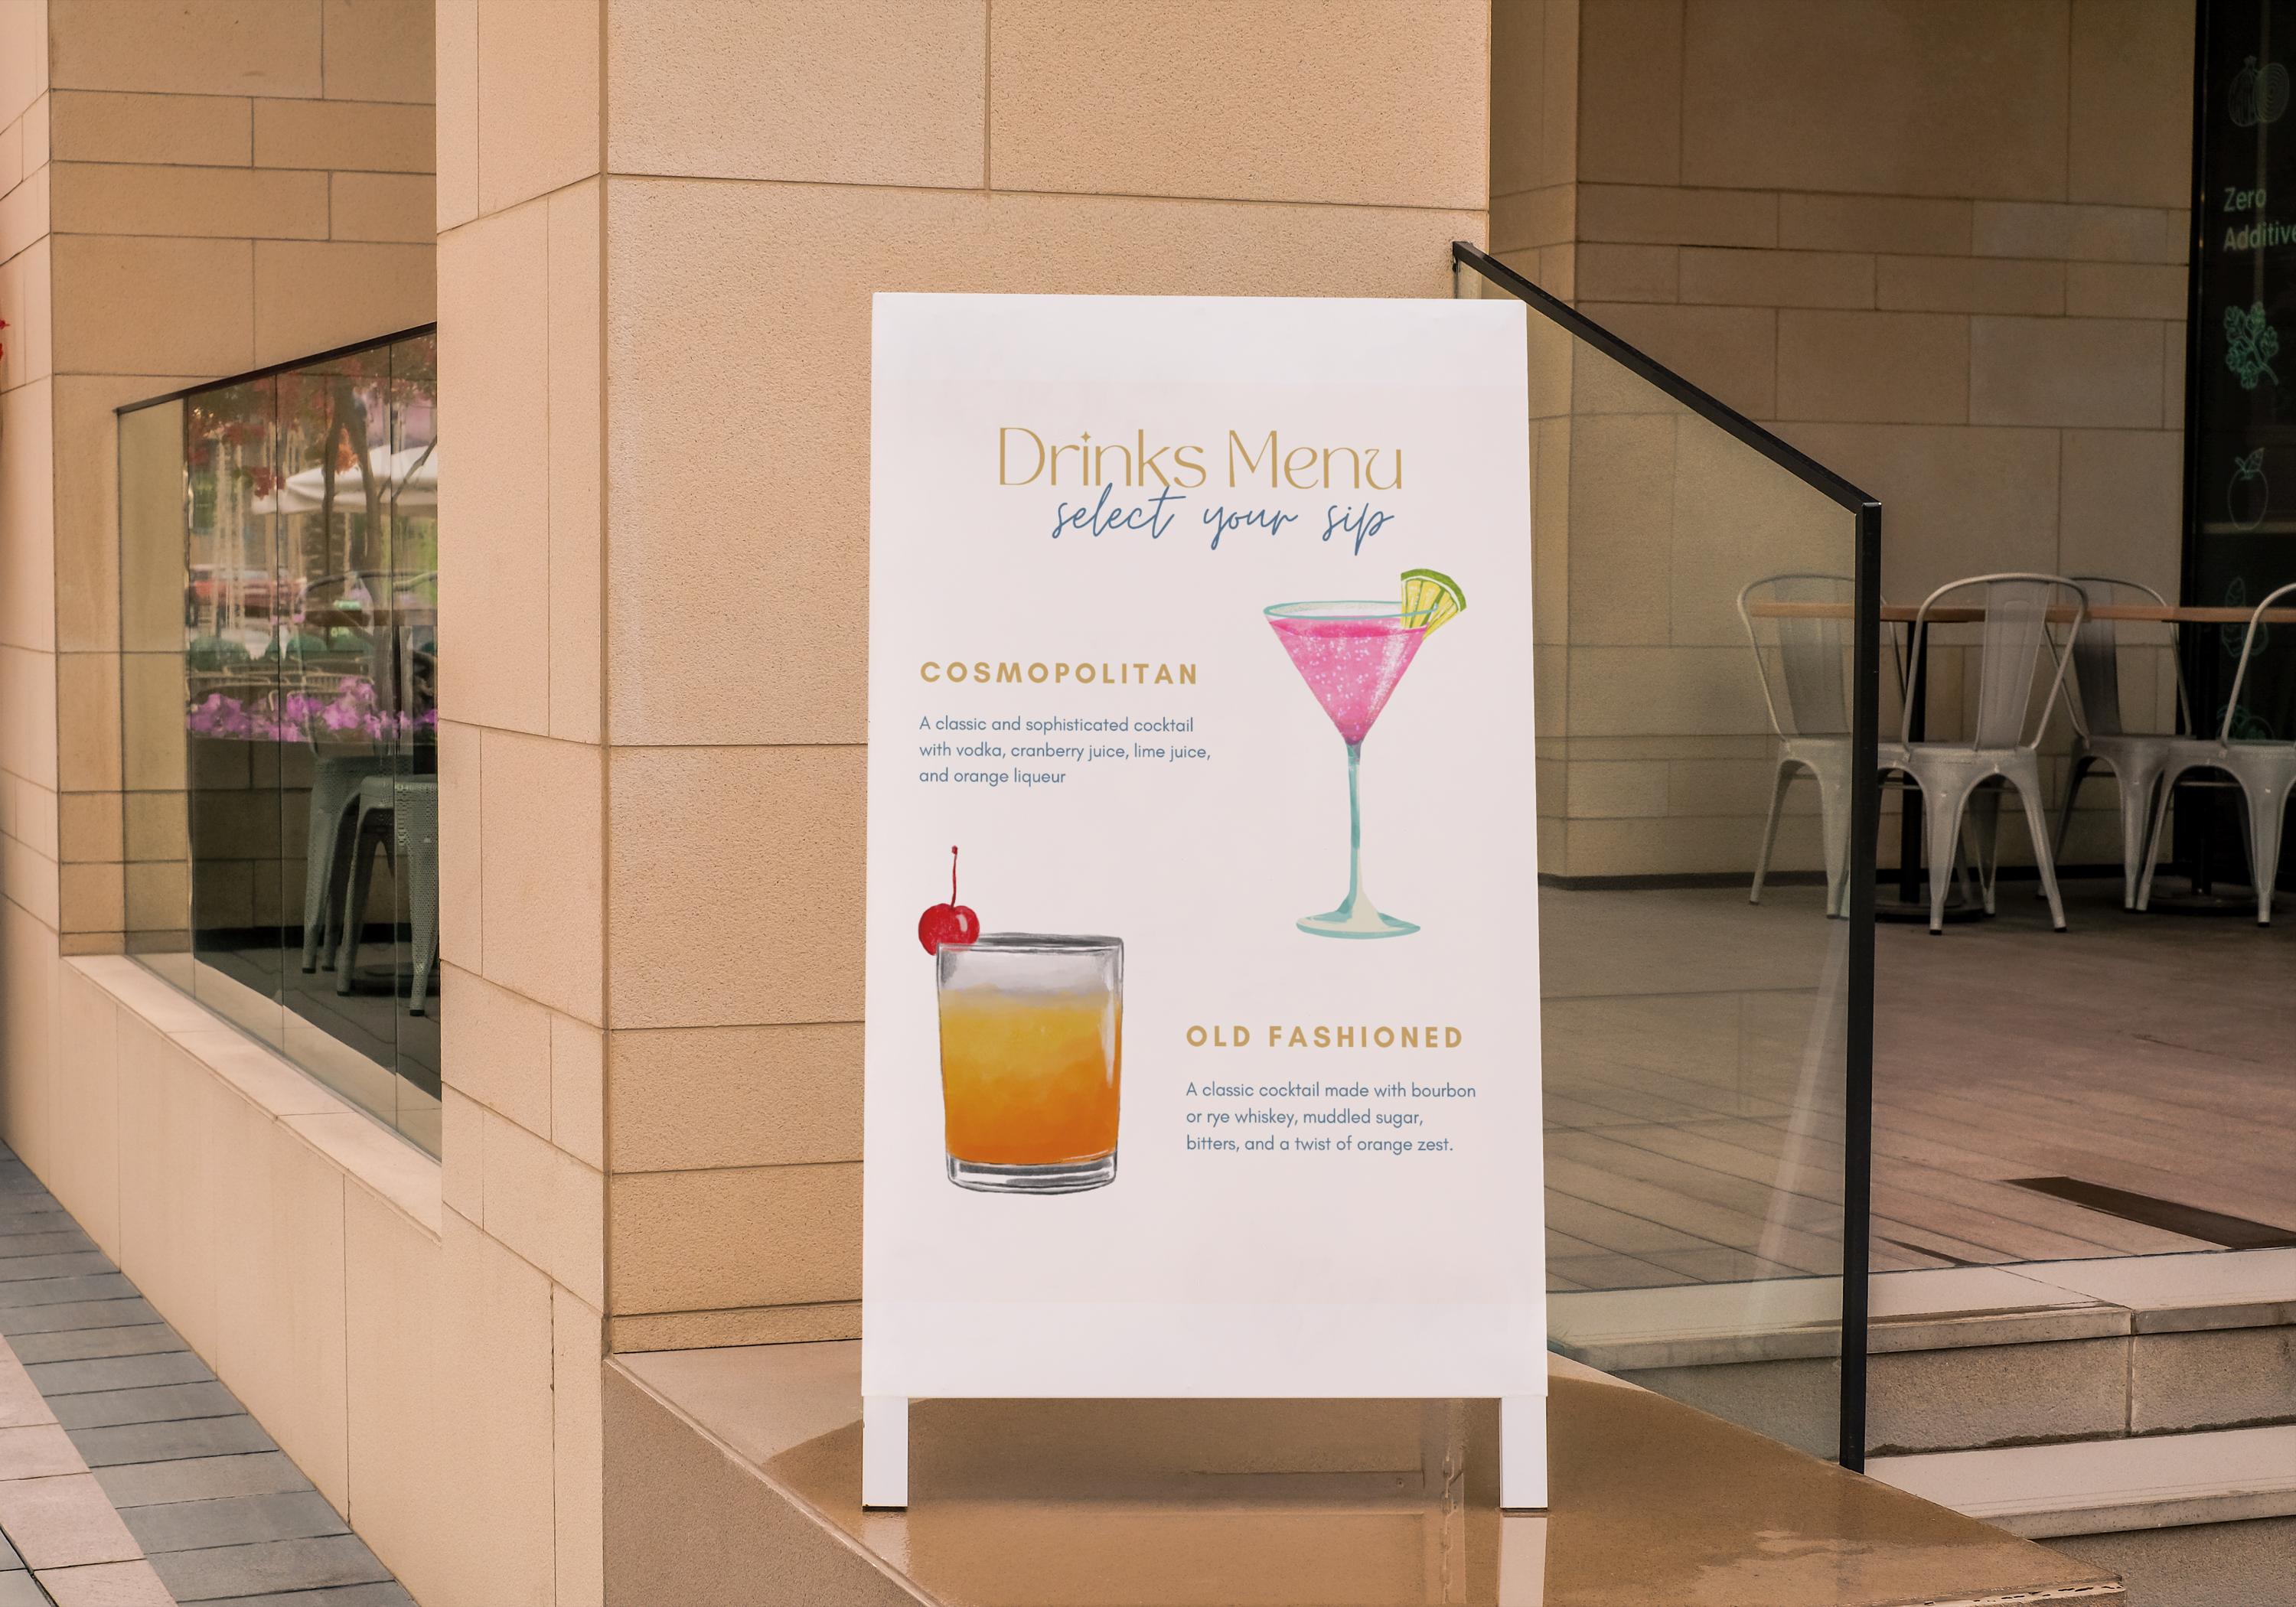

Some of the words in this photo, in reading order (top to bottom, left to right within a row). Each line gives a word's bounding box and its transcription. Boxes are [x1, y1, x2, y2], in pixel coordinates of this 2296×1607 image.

[2223, 187, 2266, 212] Zero
[999, 427, 1208, 489] Drinks
[1228, 429, 1403, 491] Menu
[1052, 482, 1187, 539] select
[1202, 505, 1299, 551] your
[1322, 502, 1396, 556] sip
[920, 661, 1198, 686] COSMOPOLITAN
[919, 716, 931, 730] A
[935, 715, 987, 731] classic
[991, 715, 1021, 731] and
[1026, 715, 1129, 735] sophisticated
[1133, 716, 1194, 732] cocktail
[919, 741, 951, 757] with
[957, 741, 1006, 759] vodka,
[1010, 742, 1084, 762] cranberry
[1088, 744, 1130, 762] juice,
[1134, 742, 1166, 758] lime
[1169, 745, 1211, 763] juice,
[919, 767, 949, 783] and
[954, 772, 1009, 787] orange
[1014, 768, 1066, 788] liqueur
[1186, 1025, 1251, 1048] OLD
[1269, 1025, 1463, 1048] FASHIONED
[1186, 1081, 1198, 1097] A
[1202, 1081, 1254, 1097] classic
[1259, 1081, 1319, 1097] cocktail
[1325, 1081, 1369, 1097] made
[1374, 1081, 1407, 1097] with
[1411, 1081, 1476, 1098] bourbon
[1186, 1112, 1202, 1123] or
[1207, 1113, 1231, 1128] rye
[1234, 1108, 1299, 1128] whiskey,
[1303, 1108, 1371, 1124] muddled
[1375, 1113, 1424, 1129] sugar,
[1186, 1134, 1240, 1152] bitters,
[1244, 1135, 1274, 1151] and
[1279, 1140, 1290, 1151] a
[1294, 1136, 1332, 1151] twist
[1336, 1135, 1353, 1151] of
[1356, 1140, 1413, 1156] orange
[1417, 1137, 1453, 1152] zest.
